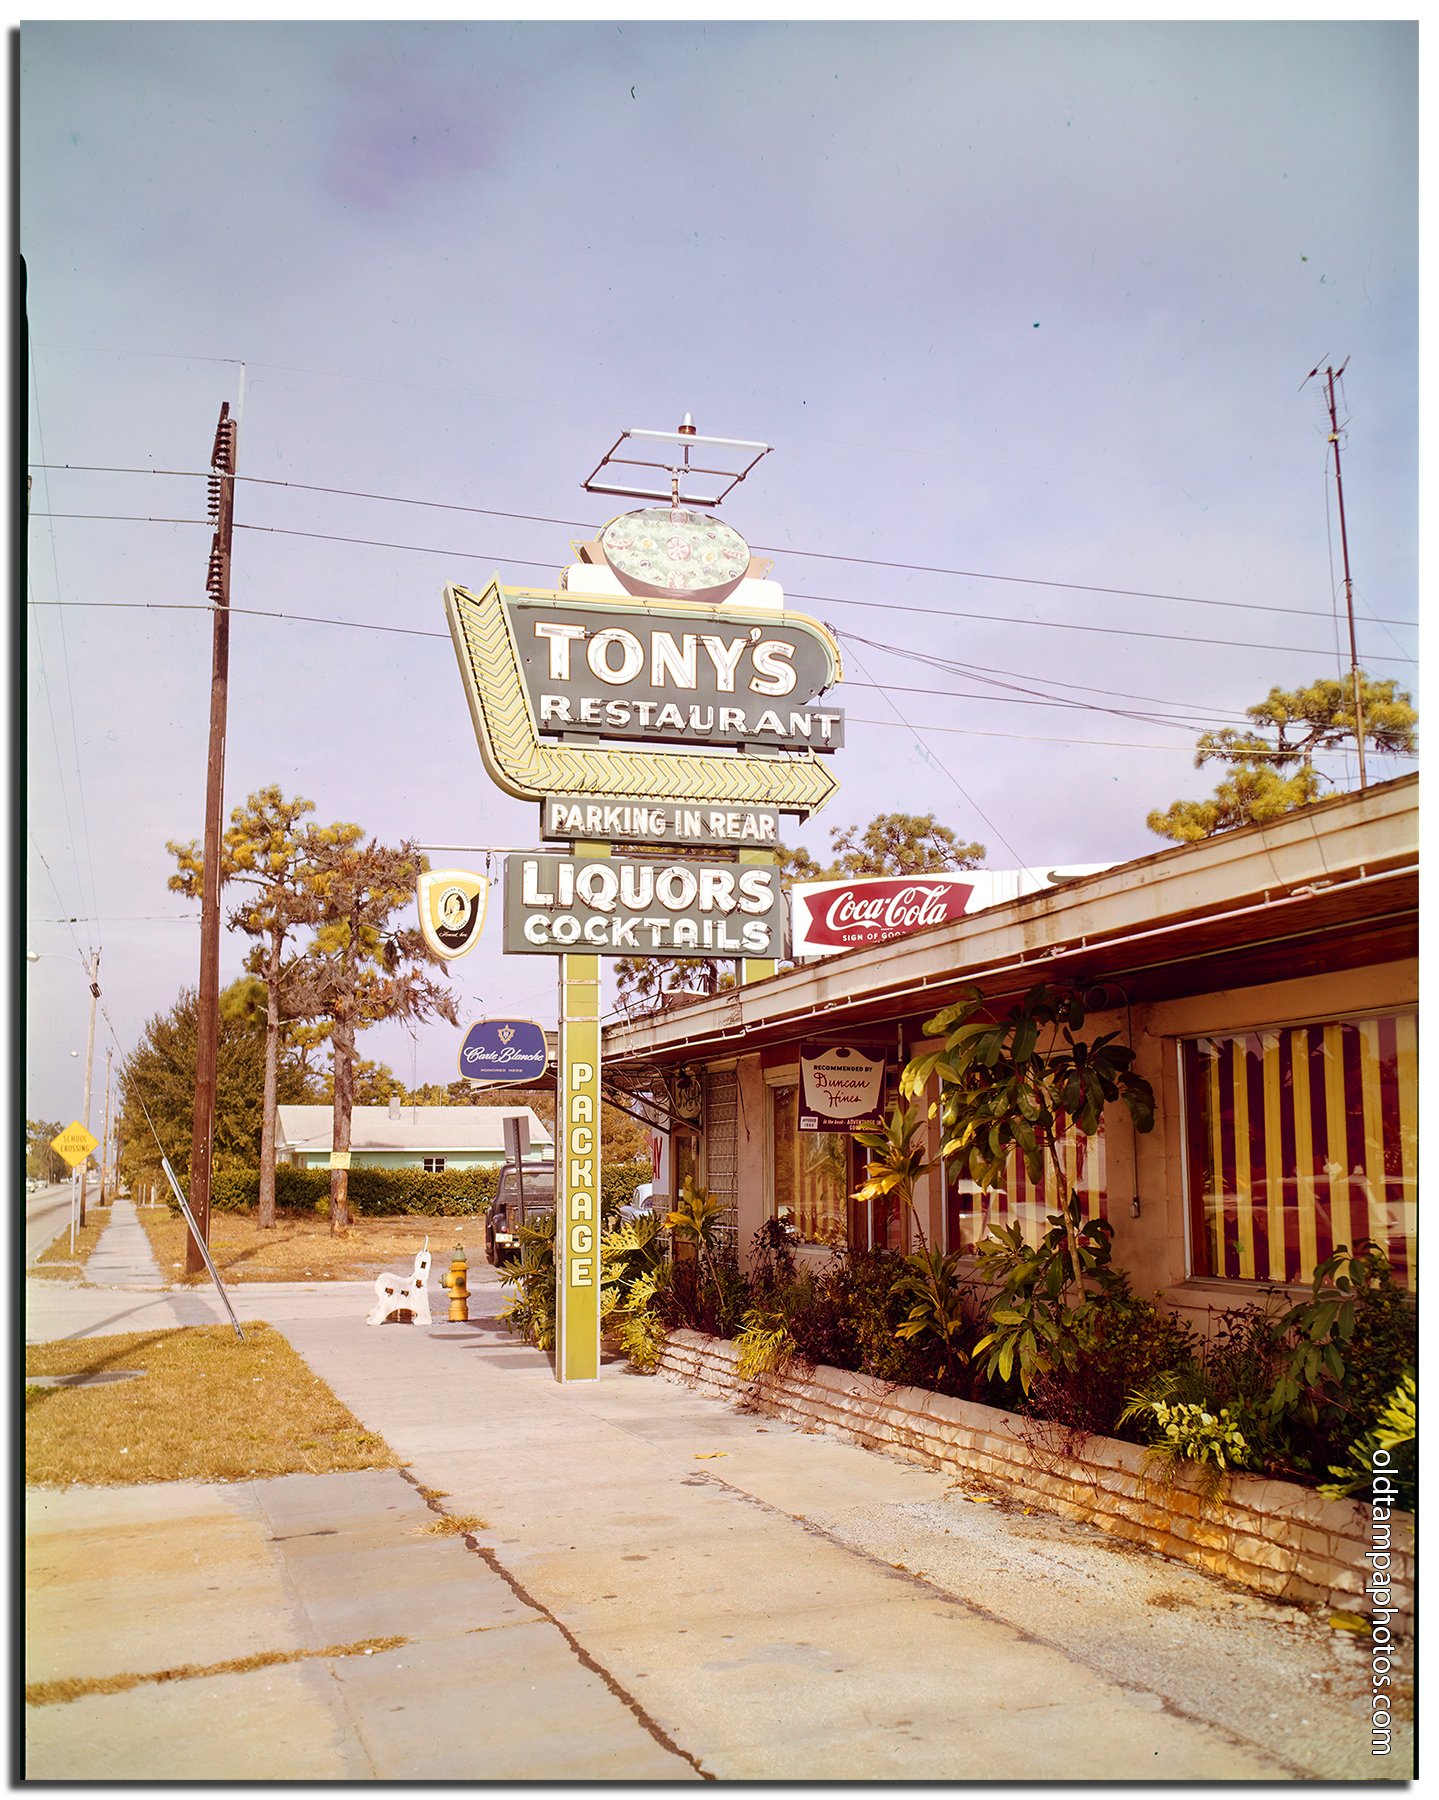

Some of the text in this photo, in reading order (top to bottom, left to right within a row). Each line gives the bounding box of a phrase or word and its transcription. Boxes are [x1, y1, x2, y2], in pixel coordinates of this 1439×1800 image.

[534, 620, 798, 697] TONY'S
[539, 694, 841, 741] RESTAURANT
[551, 803, 776, 842] PARKING IN REAR
[522, 860, 775, 916] LIQUORS
[826, 885, 952, 931] Coca-Cola
[523, 914, 771, 952] COCKTAILS
[842, 931, 906, 942] SIGN OF GOO
[463, 1046, 544, 1063] Carte Blanche
[813, 1072, 870, 1088] Duncan
[823, 1090, 862, 1108] Hines
[60, 1144, 90, 1153] CROSSING
[63, 1135, 86, 1143] SCHOOL
[570, 1062, 594, 1287] PACKAGE
